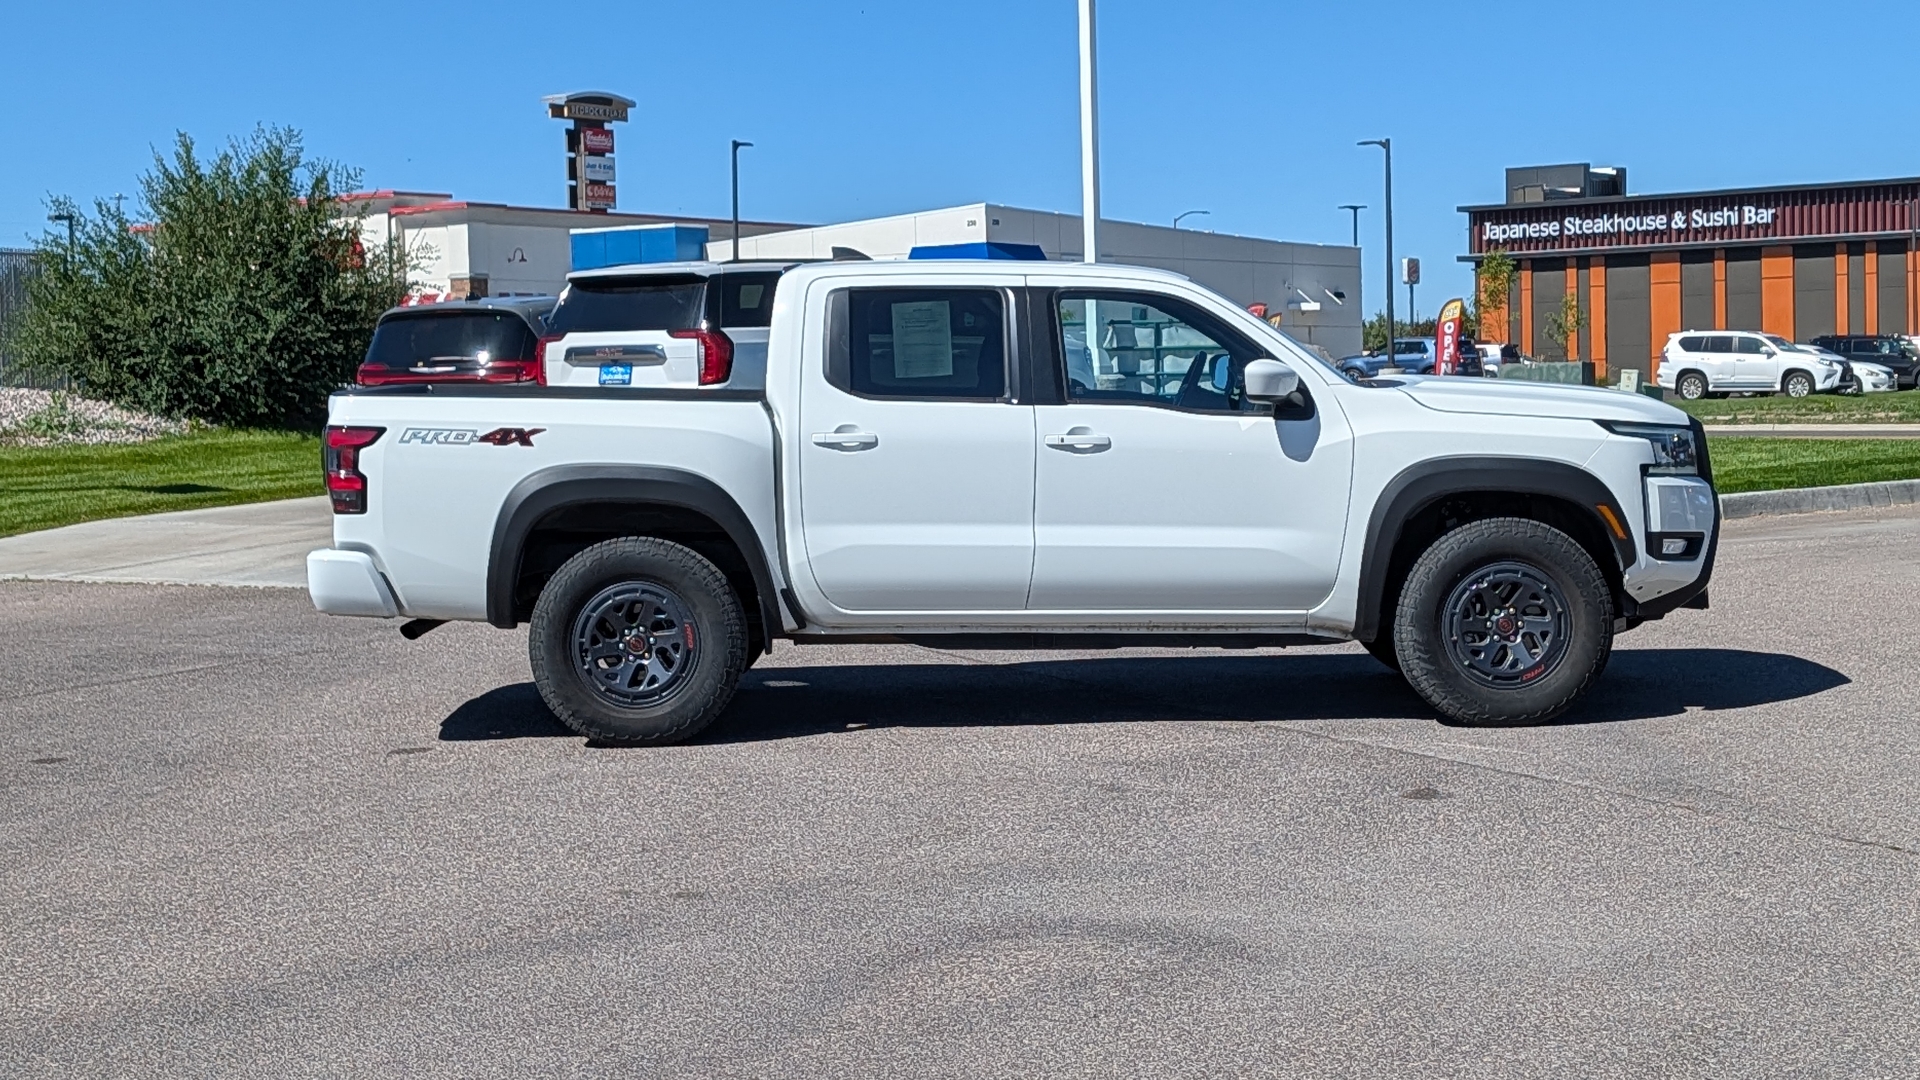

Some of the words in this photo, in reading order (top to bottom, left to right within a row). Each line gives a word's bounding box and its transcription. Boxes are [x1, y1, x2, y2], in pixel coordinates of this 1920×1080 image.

[606, 108, 626, 117] PLAZA
[1482, 220, 1560, 243] Japanese
[1564, 212, 1667, 236] Steakhouse
[1671, 210, 1687, 230] &
[1691, 205, 1739, 229] Sushi
[1742, 205, 1776, 226] Bar
[1440, 321, 1455, 376] OPEN
